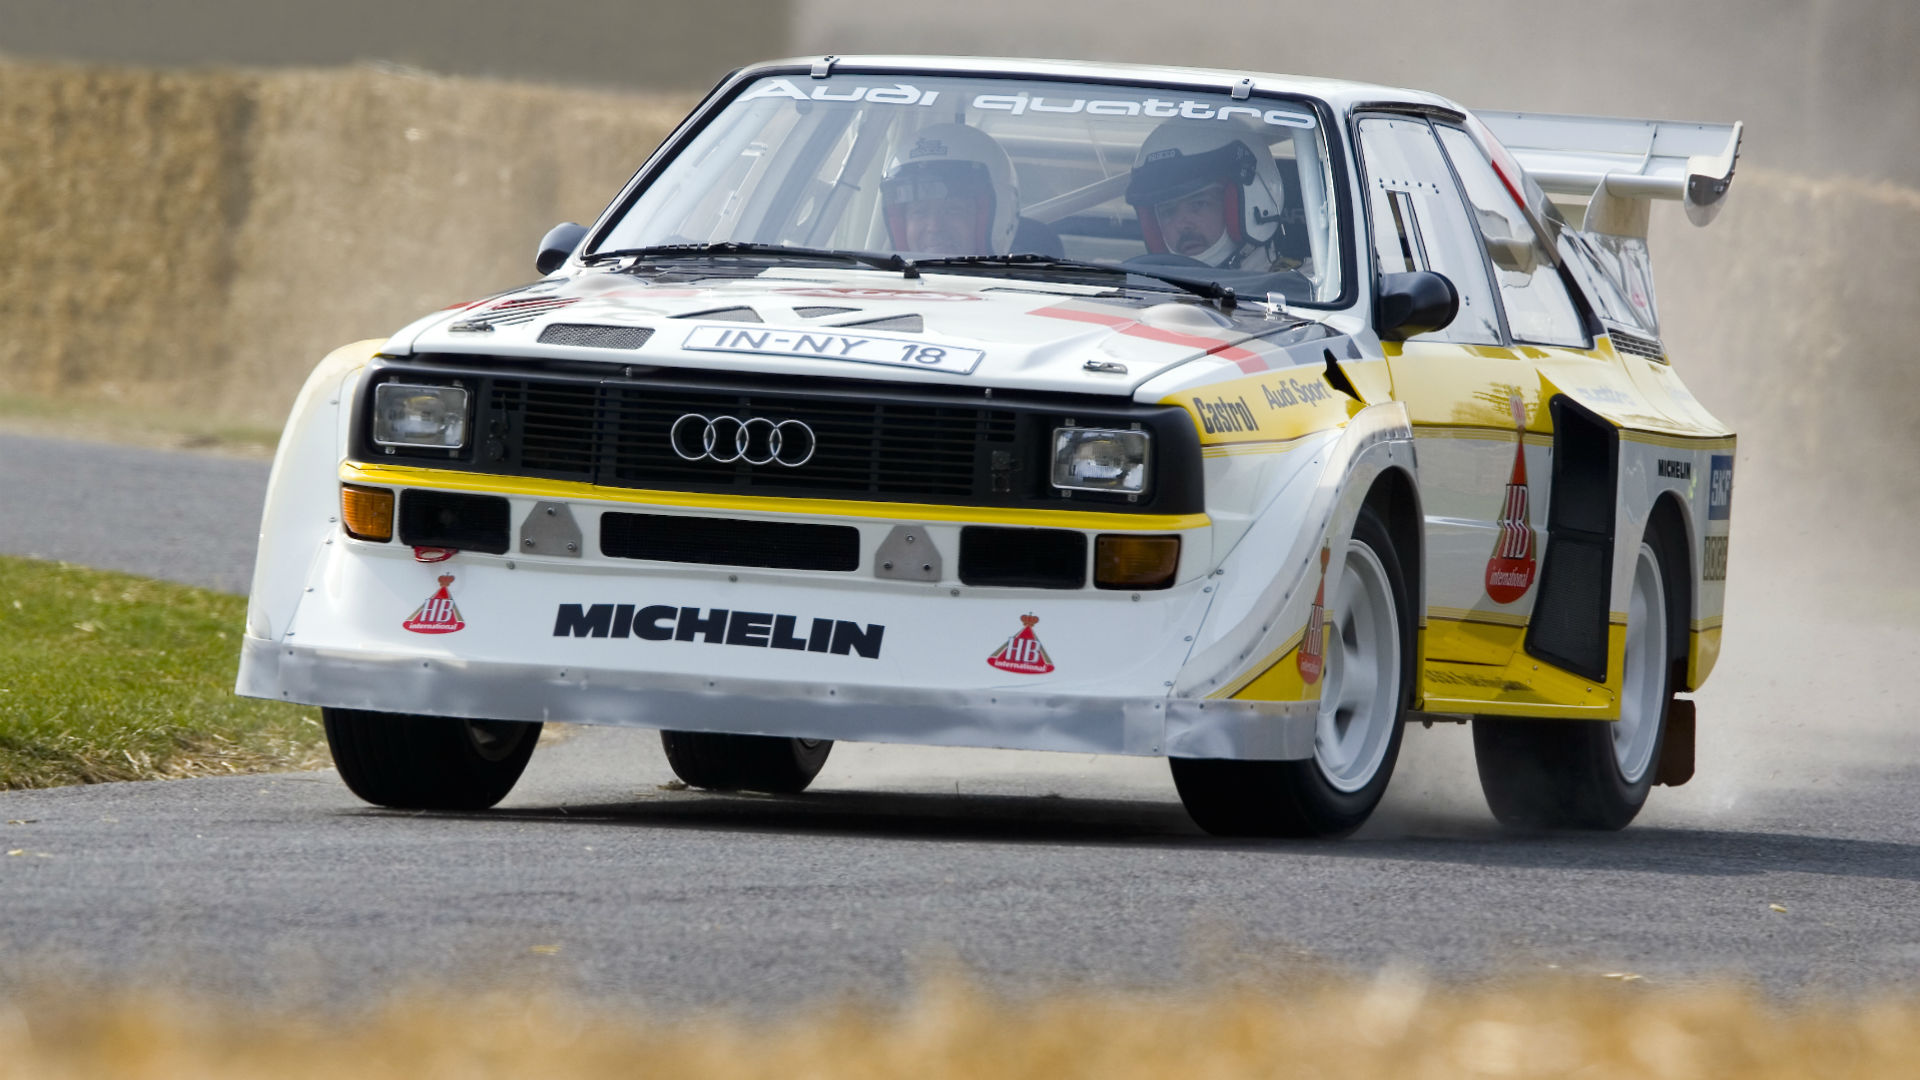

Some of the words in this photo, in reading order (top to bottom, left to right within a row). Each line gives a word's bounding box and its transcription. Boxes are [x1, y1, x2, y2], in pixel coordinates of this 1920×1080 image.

[735, 79, 940, 106] Audi
[973, 92, 1316, 129] quattro
[714, 330, 869, 355] IN-NY
[899, 343, 947, 365] 18
[1261, 380, 1299, 410] Audi
[1289, 378, 1332, 407] Sport
[1192, 395, 1260, 434] Castrol
[1658, 459, 1691, 480] MICHELIN
[1711, 469, 1732, 506] SKF
[1490, 565, 1530, 588] international
[420, 599, 454, 622] HB
[408, 622, 458, 630] international
[553, 604, 885, 659] MICHELIN
[1005, 636, 1041, 663] HB
[994, 659, 1047, 672] international
